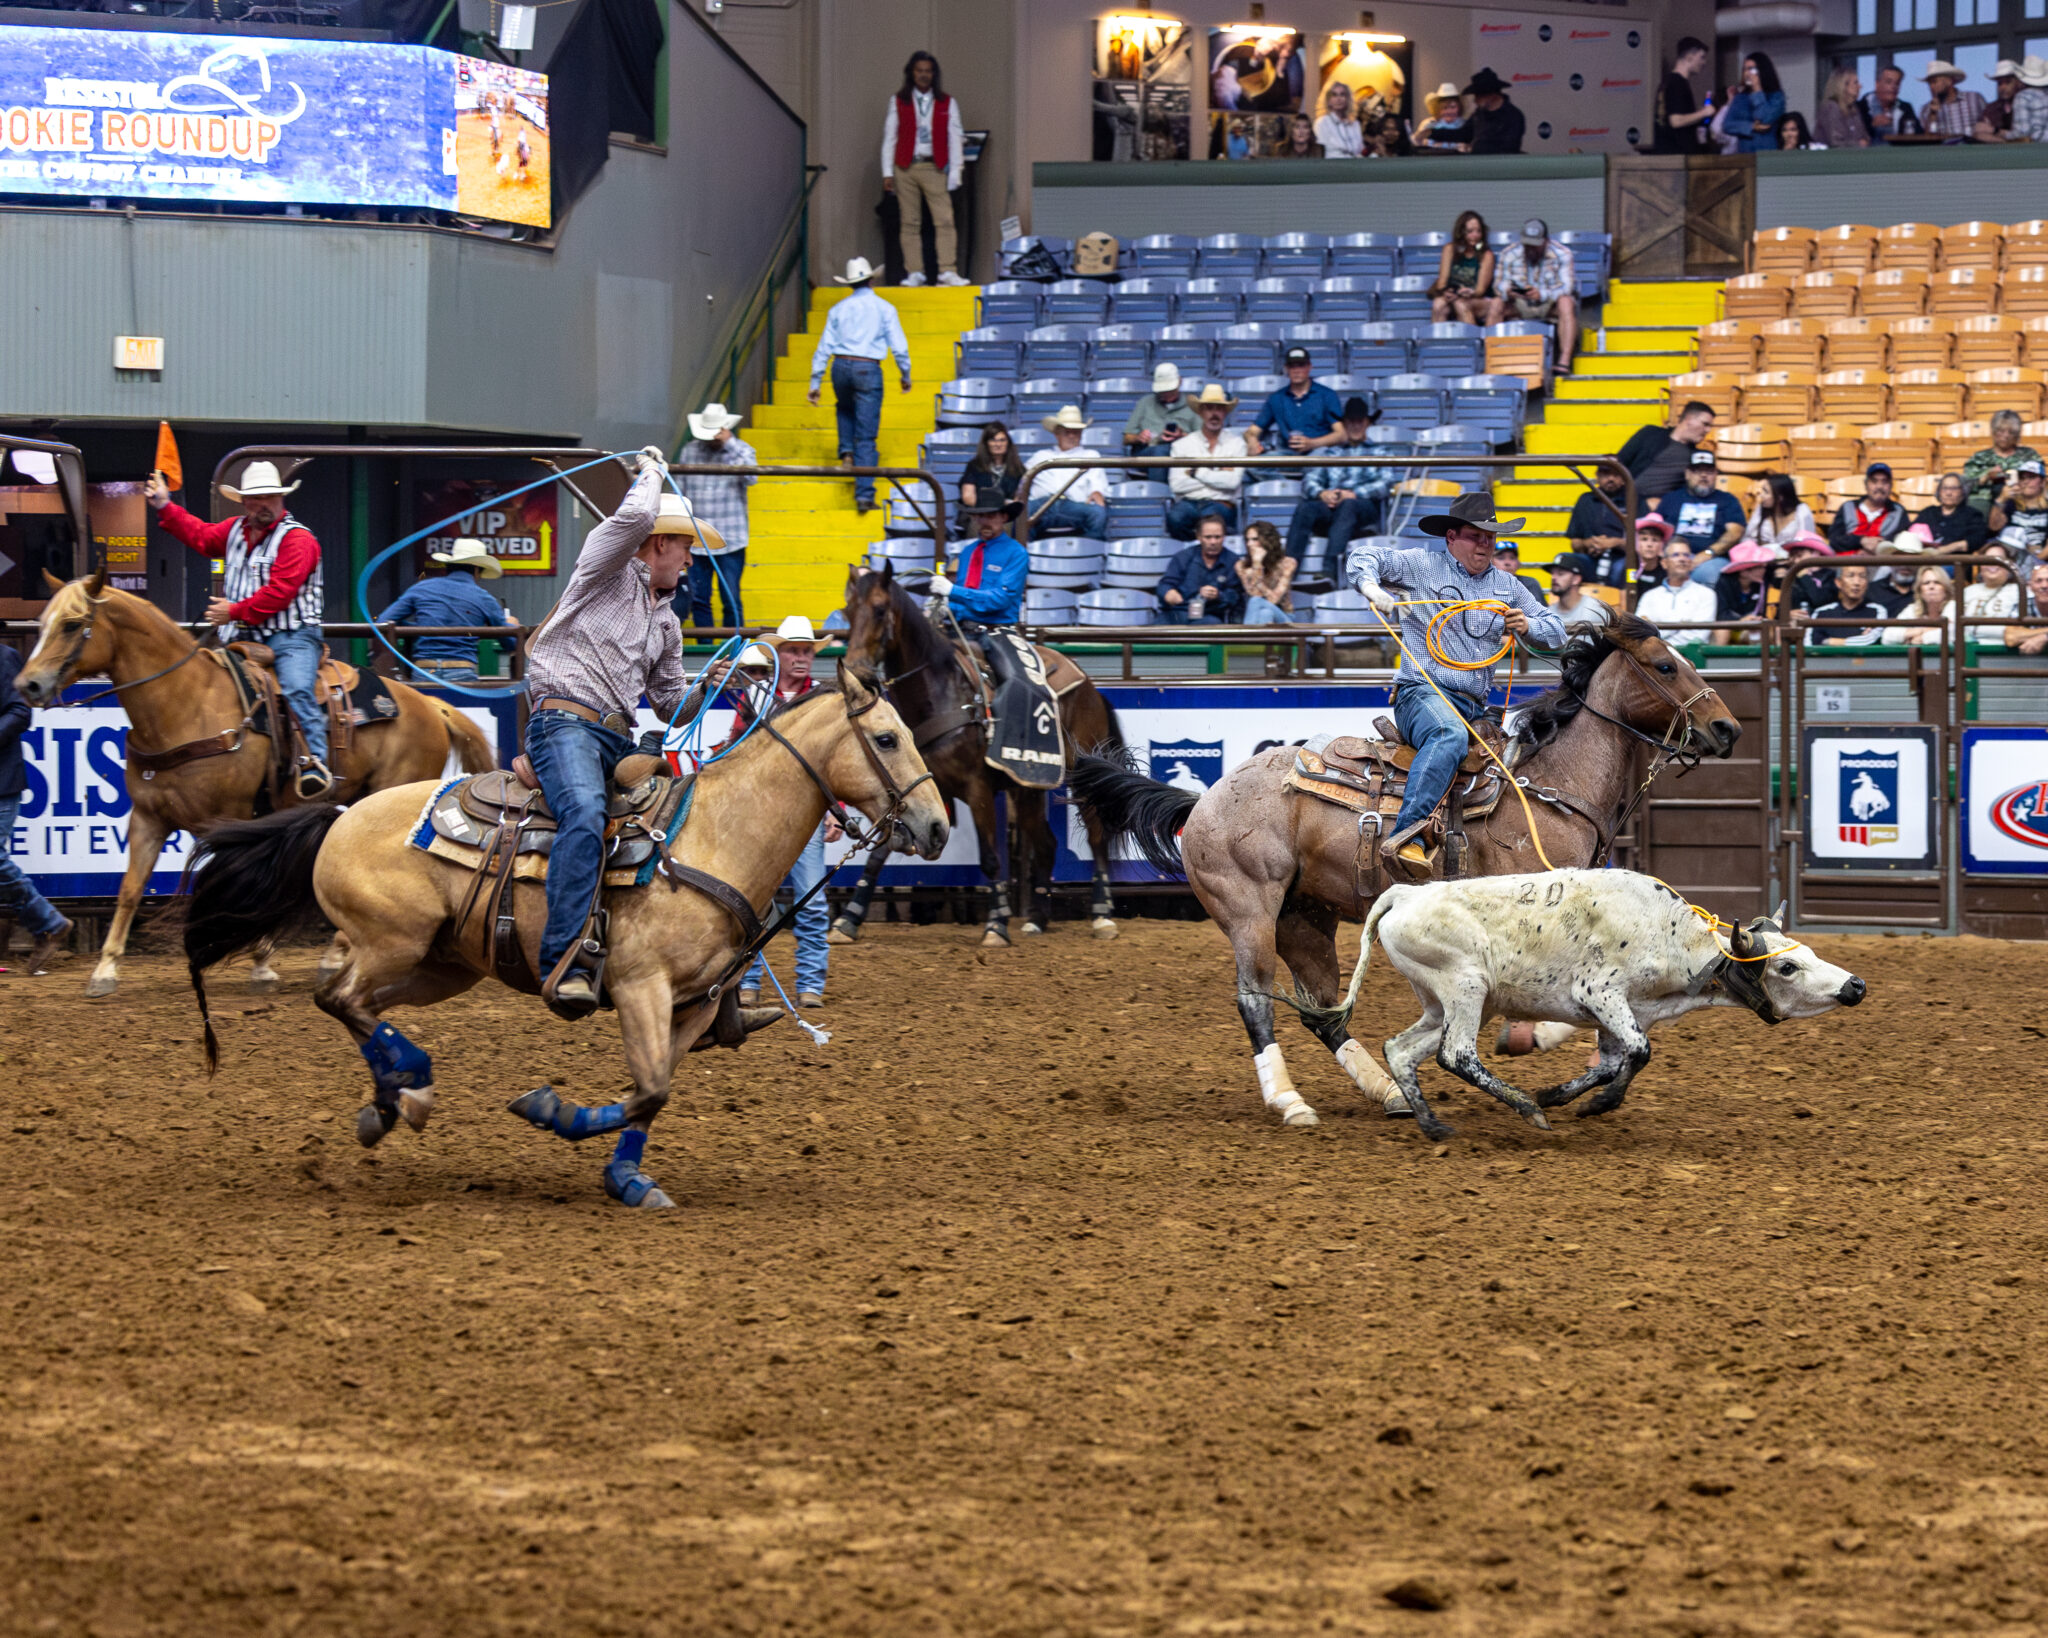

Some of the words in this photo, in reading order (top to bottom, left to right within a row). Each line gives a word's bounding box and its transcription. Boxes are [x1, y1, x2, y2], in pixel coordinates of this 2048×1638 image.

[0, 108, 89, 146] OKIE
[107, 112, 277, 157] ROUNDUP
[459, 511, 506, 535] VIP
[426, 537, 537, 554] RERVED
[1001, 746, 1061, 766] RAM
[1151, 748, 1222, 758] PRORODEO
[1840, 759, 1898, 769] PRORODEO
[45, 826, 75, 855] IT
[1517, 881, 1564, 907] 20
